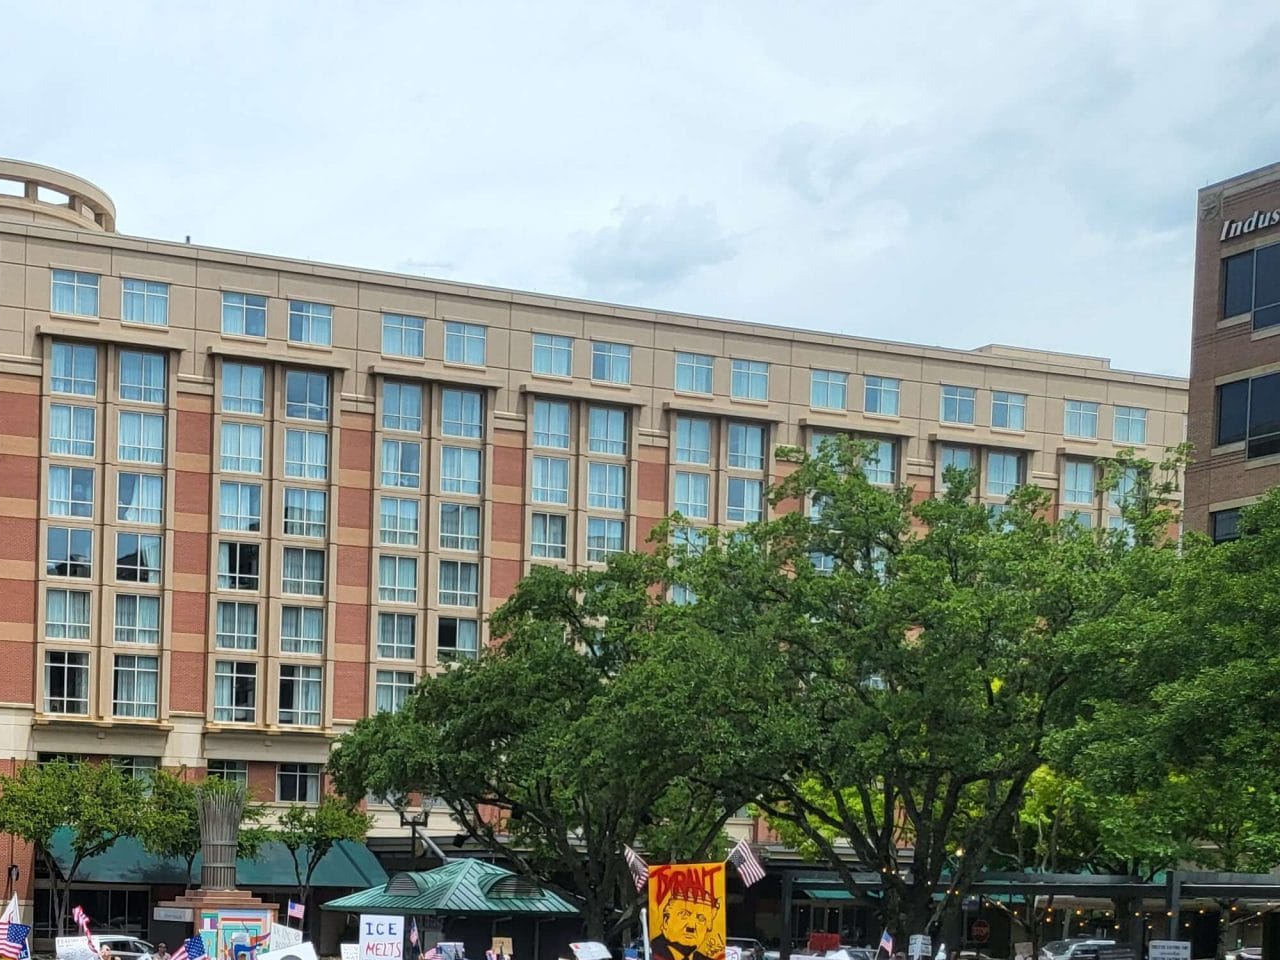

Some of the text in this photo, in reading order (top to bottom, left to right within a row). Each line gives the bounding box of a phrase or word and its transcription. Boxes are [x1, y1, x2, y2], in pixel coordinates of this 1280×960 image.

[1220, 208, 1280, 241] Indus
[366, 922, 397, 936] ICE
[366, 941, 401, 958] MELTS
